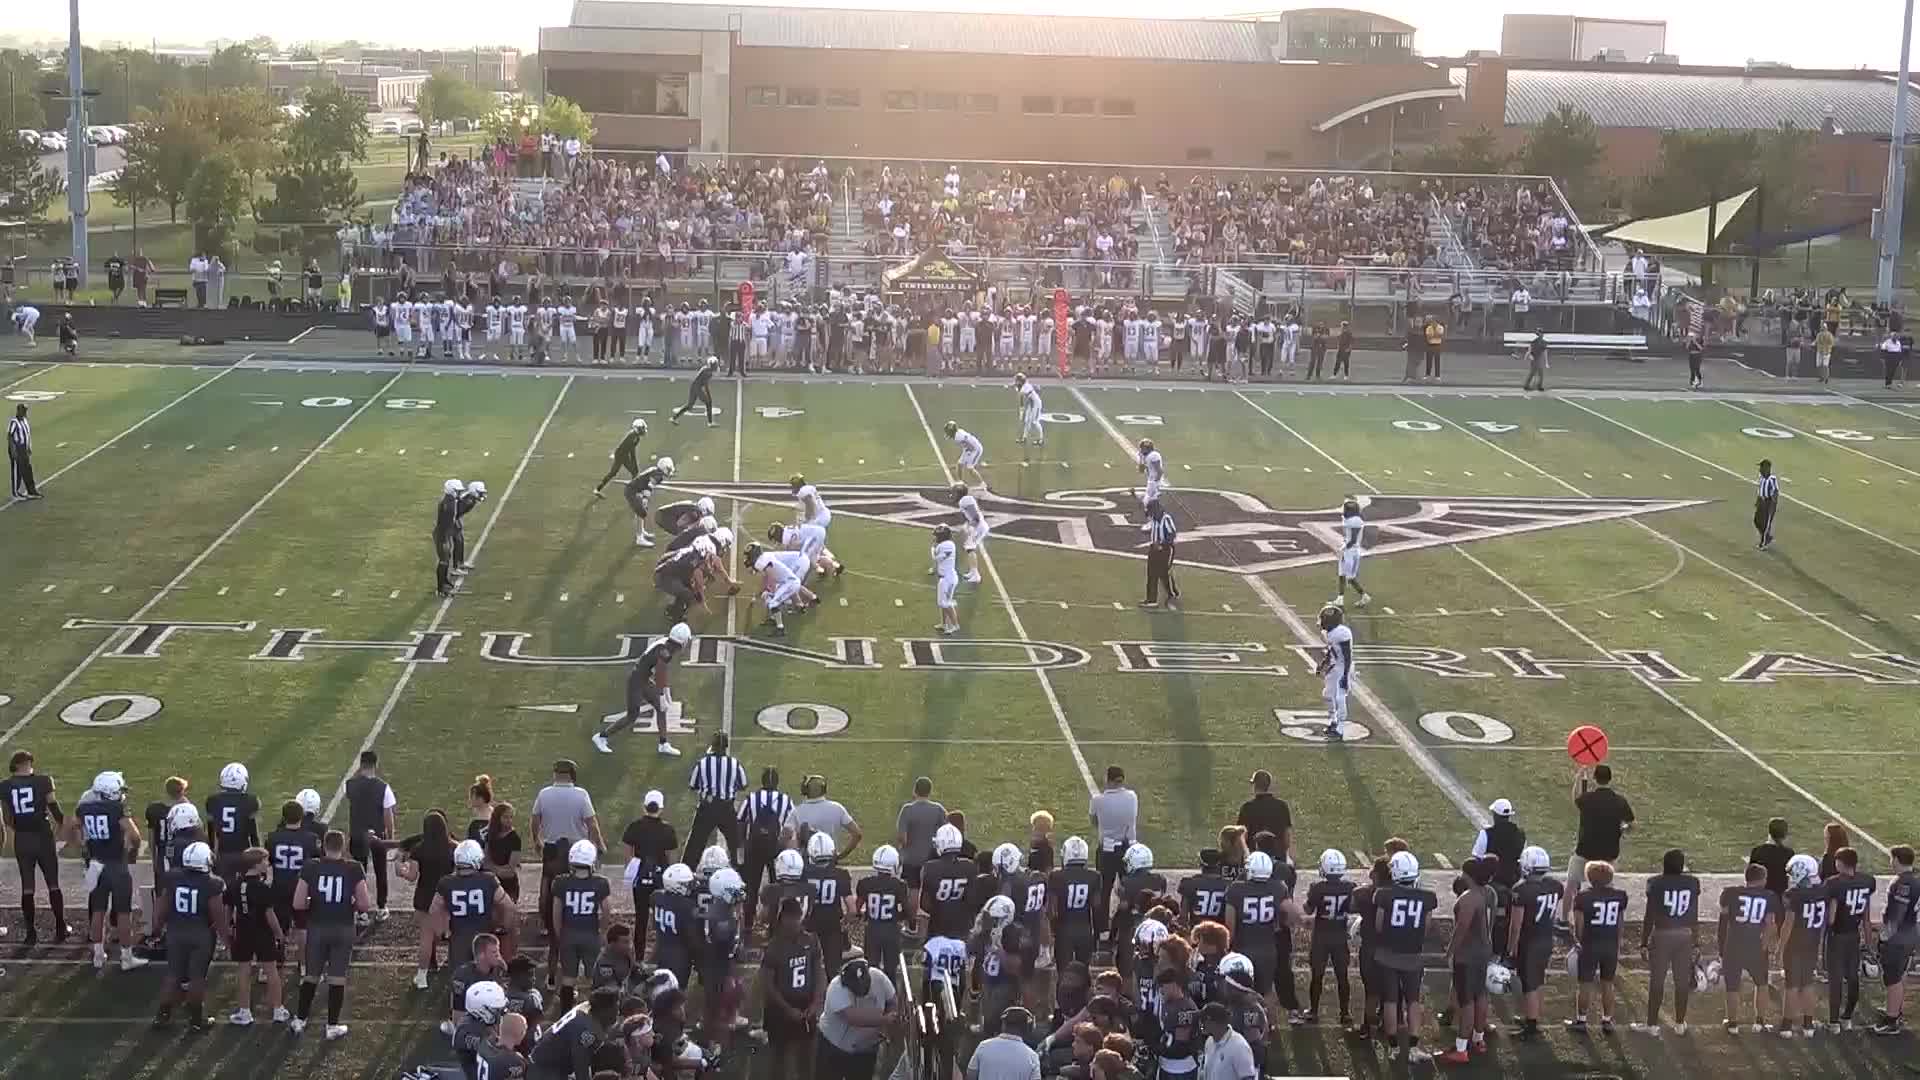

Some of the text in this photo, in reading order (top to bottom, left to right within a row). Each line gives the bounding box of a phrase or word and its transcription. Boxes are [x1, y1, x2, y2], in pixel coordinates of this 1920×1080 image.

[11, 787, 35, 814] 12
[221, 807, 237, 832] 5
[275, 844, 303, 870] 52
[175, 887, 198, 914] 61
[319, 876, 343, 903] 41
[451, 889, 485, 916] 59
[565, 891, 594, 915] 46
[936, 878, 968, 902] 85
[1068, 884, 1088, 909] 18
[1196, 890, 1225, 916] 36
[1844, 888, 1869, 916] 45
[868, 893, 895, 920] 82
[1243, 896, 1274, 924] 56
[1391, 899, 1423, 929] 64
[1535, 893, 1558, 922] 74
[1590, 901, 1618, 926] 38
[1664, 890, 1691, 917] 48
[1735, 895, 1767, 924] 30
[1802, 901, 1825, 929] 43
[654, 905, 678, 935] 49
[793, 966, 806, 988] 6
